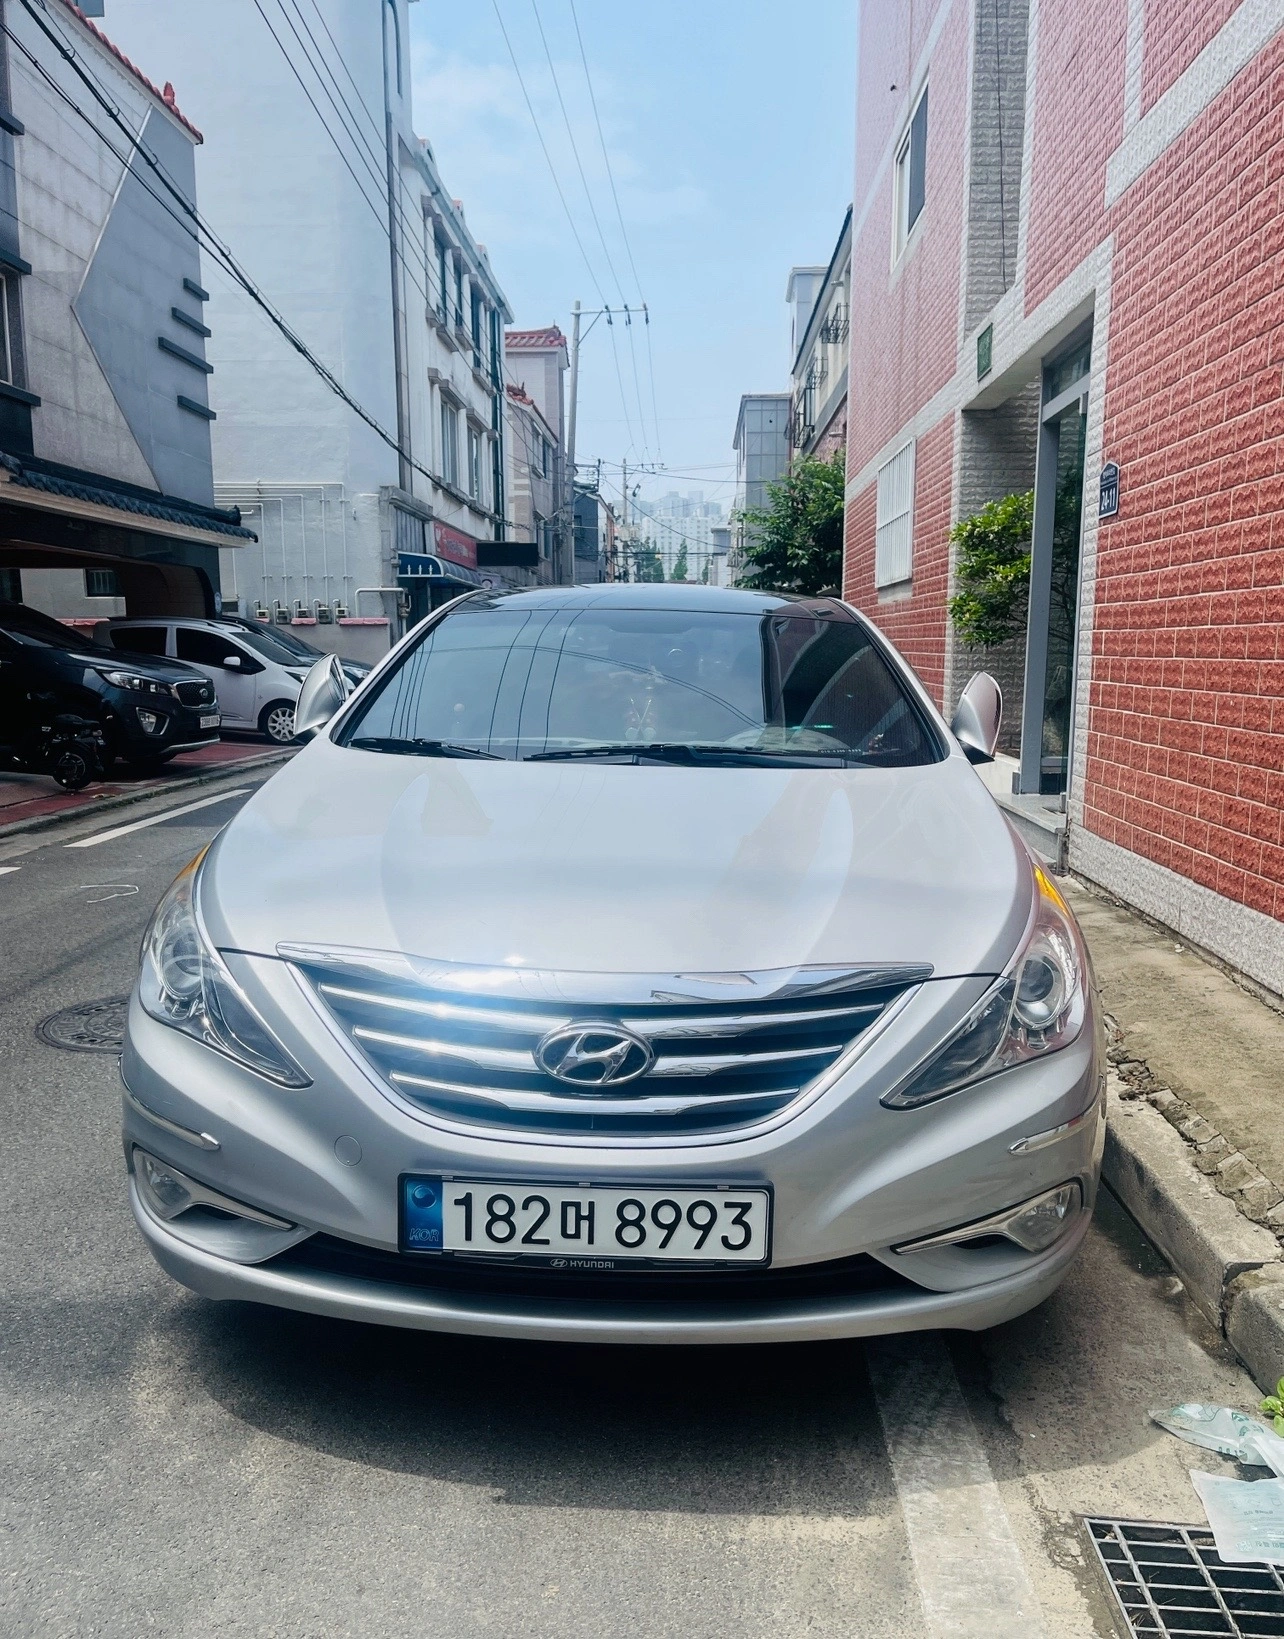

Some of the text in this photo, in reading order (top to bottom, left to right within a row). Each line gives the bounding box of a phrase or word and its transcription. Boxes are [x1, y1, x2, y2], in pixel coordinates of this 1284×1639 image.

[453, 1192, 753, 1251] 182머 8993
[409, 1227, 440, 1242] KOR
[570, 1260, 614, 1269] HYUNDAI
